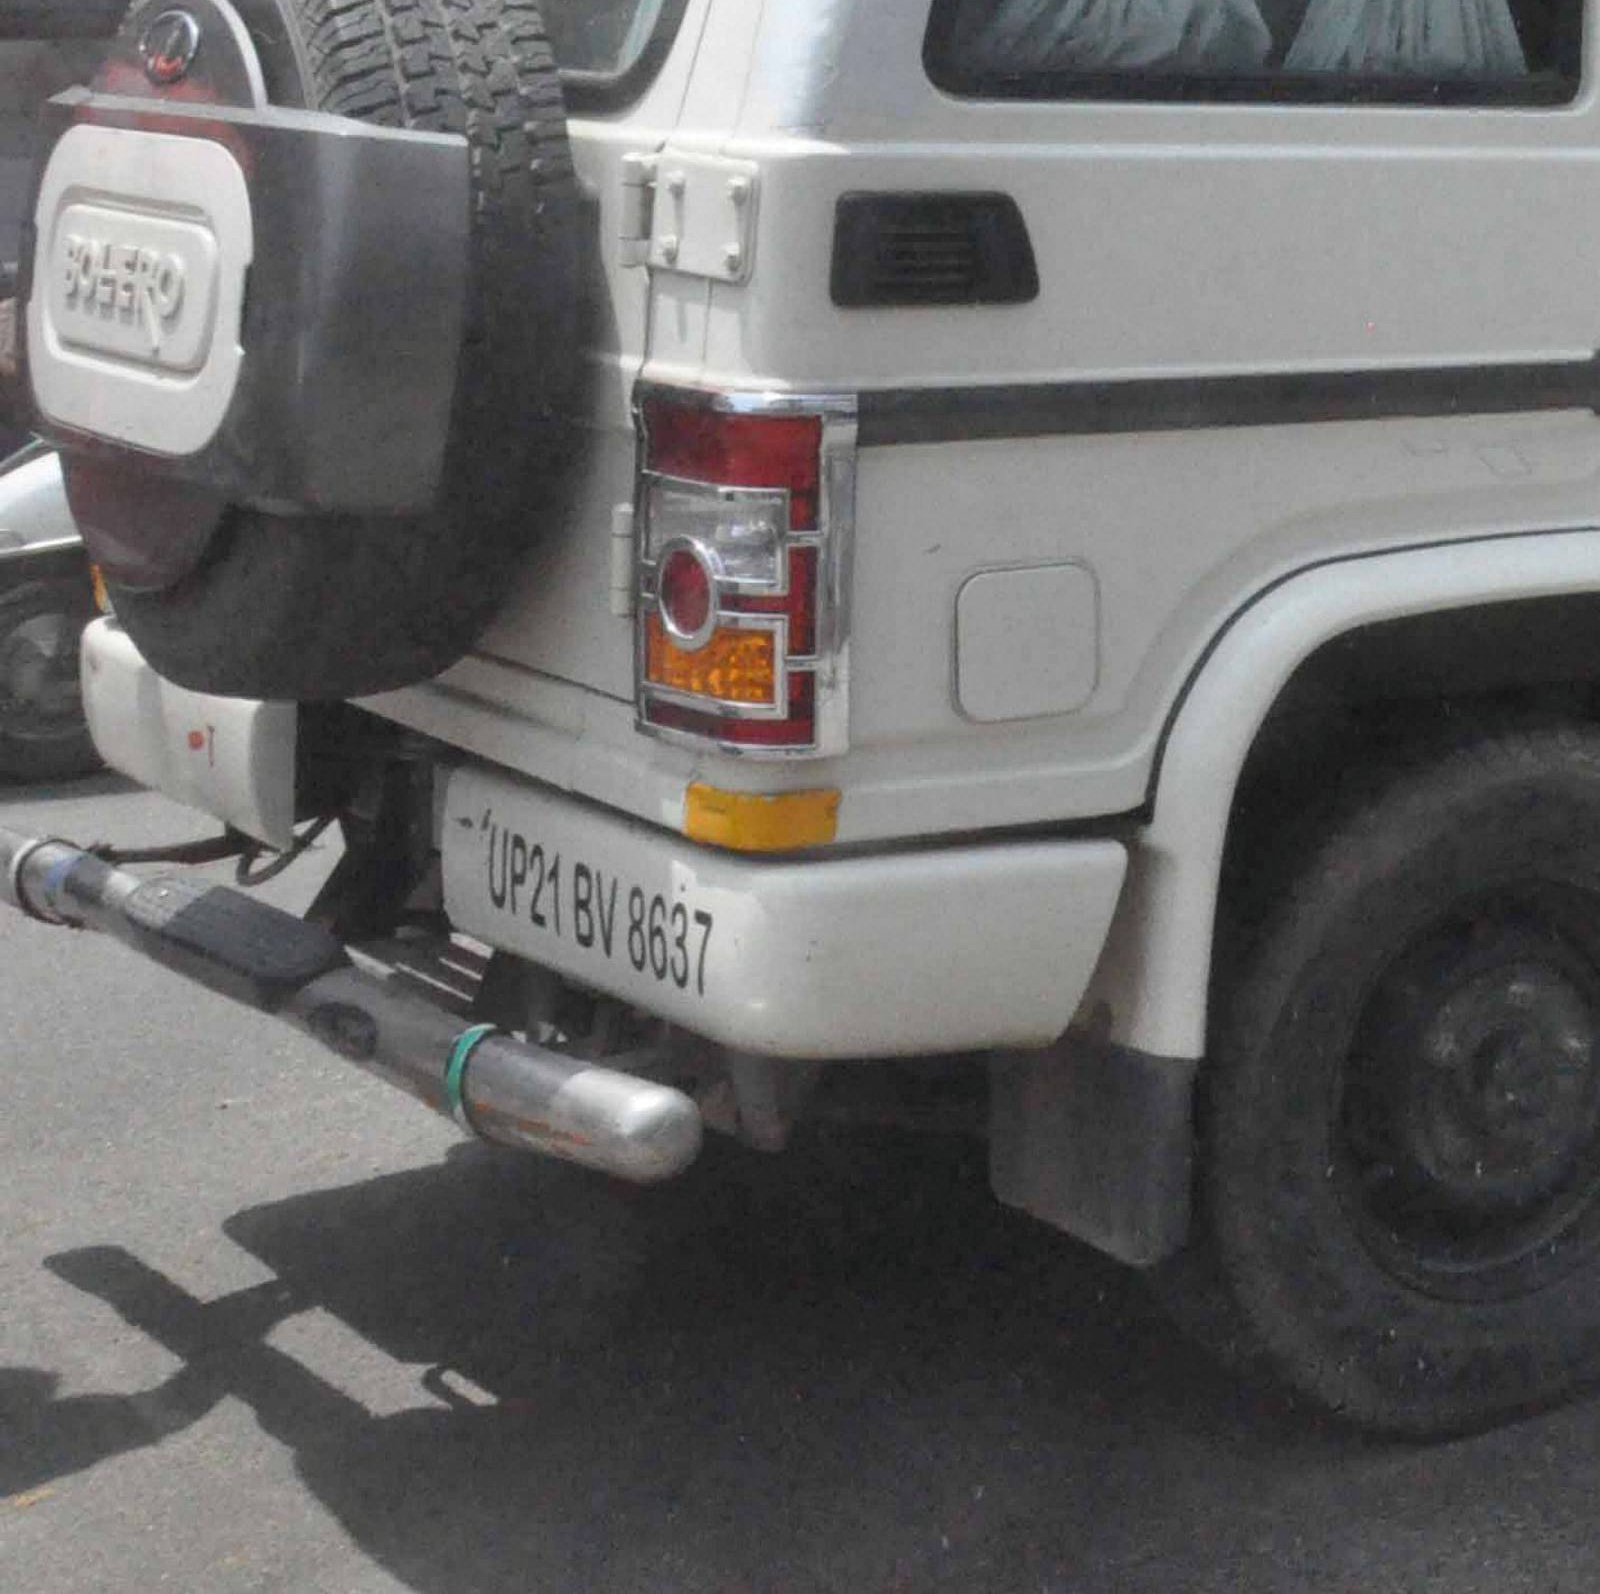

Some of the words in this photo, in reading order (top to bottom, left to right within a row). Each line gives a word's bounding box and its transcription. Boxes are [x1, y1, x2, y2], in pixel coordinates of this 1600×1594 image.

[65, 233, 187, 328] BOLERO
[488, 822, 560, 938] UP21
[572, 860, 618, 959] BV
[627, 885, 713, 998] 8637
